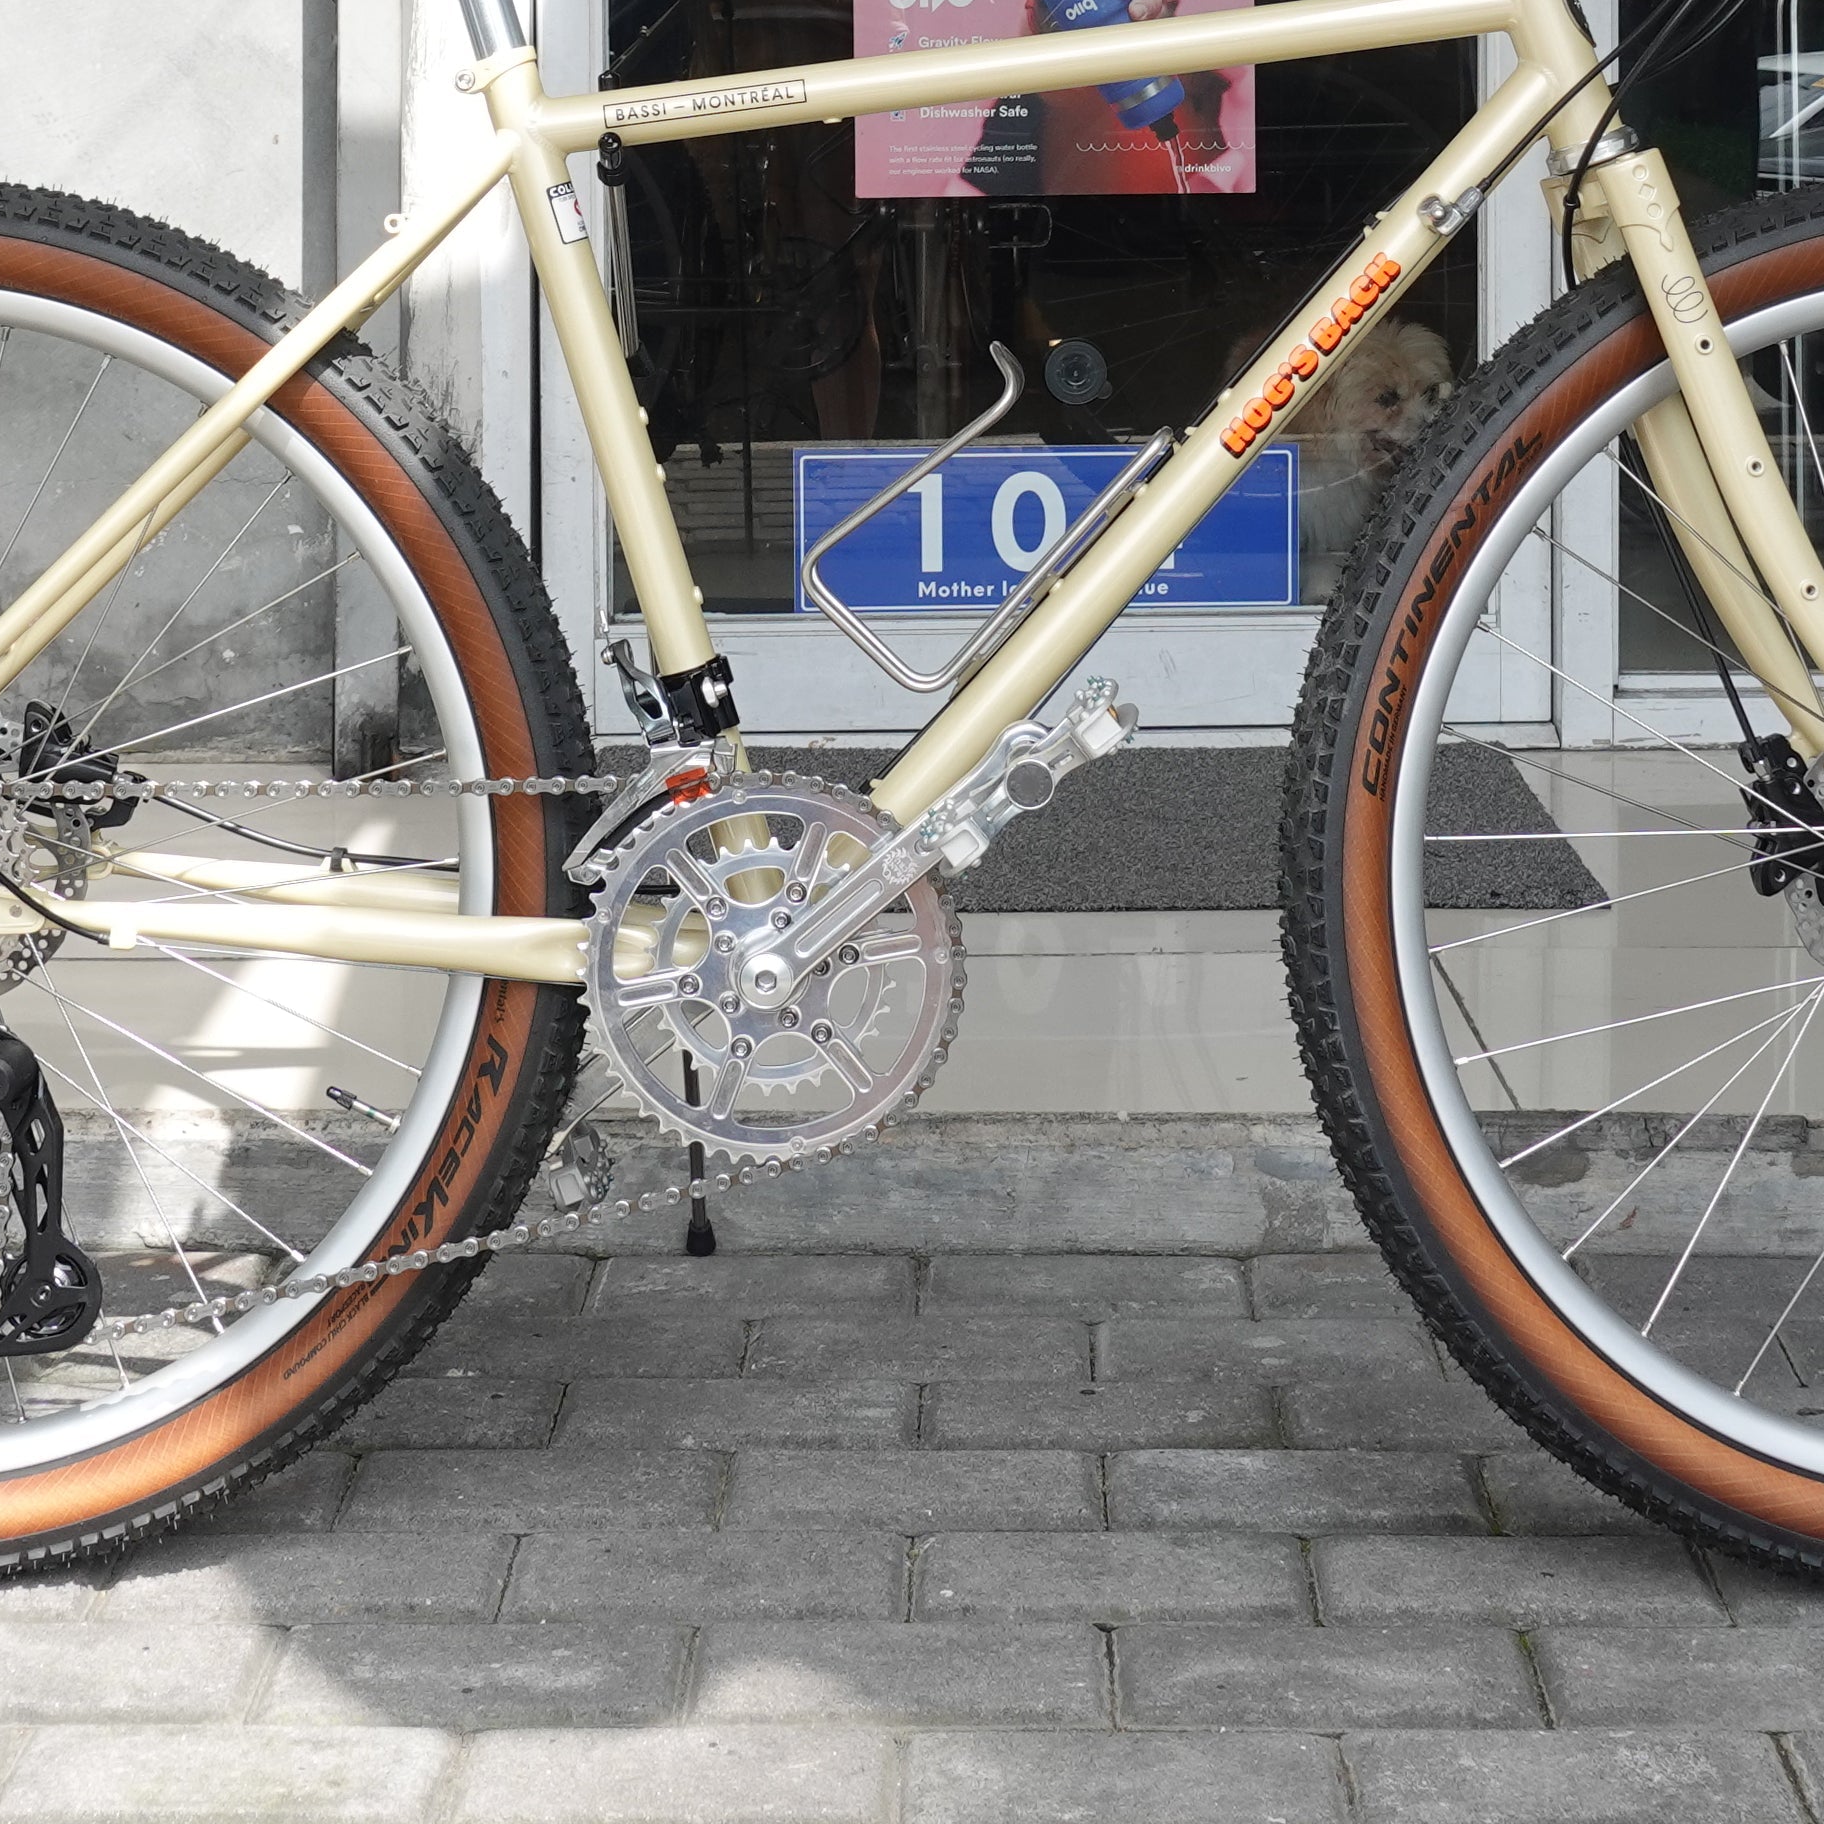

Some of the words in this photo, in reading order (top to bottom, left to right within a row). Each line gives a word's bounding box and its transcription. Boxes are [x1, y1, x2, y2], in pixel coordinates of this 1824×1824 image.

[918, 36, 967, 48] Gravity
[616, 103, 667, 121] BASSI
[692, 86, 795, 112] MONTRÉAL
[920, 106, 996, 118] Dishwasher
[999, 105, 1029, 118] Safe
[969, 144, 993, 153] cycling
[1016, 143, 1037, 151] bottle
[1015, 155, 1036, 163] really,
[903, 168, 933, 176] engineer
[973, 166, 999, 174] NASA).
[1219, 343, 1319, 459] HOG'S
[1308, 252, 1401, 357] BACK
[918, 581, 994, 598] Mother
[1362, 430, 1543, 796] CONTINENTAL
[1391, 684, 1408, 732] GERMANY
[1388, 731, 1396, 745] IN
[1379, 745, 1394, 803] HANDMADE
[346, 1295, 370, 1322] BLACK
[283, 1338, 328, 1381] COMPOUND
